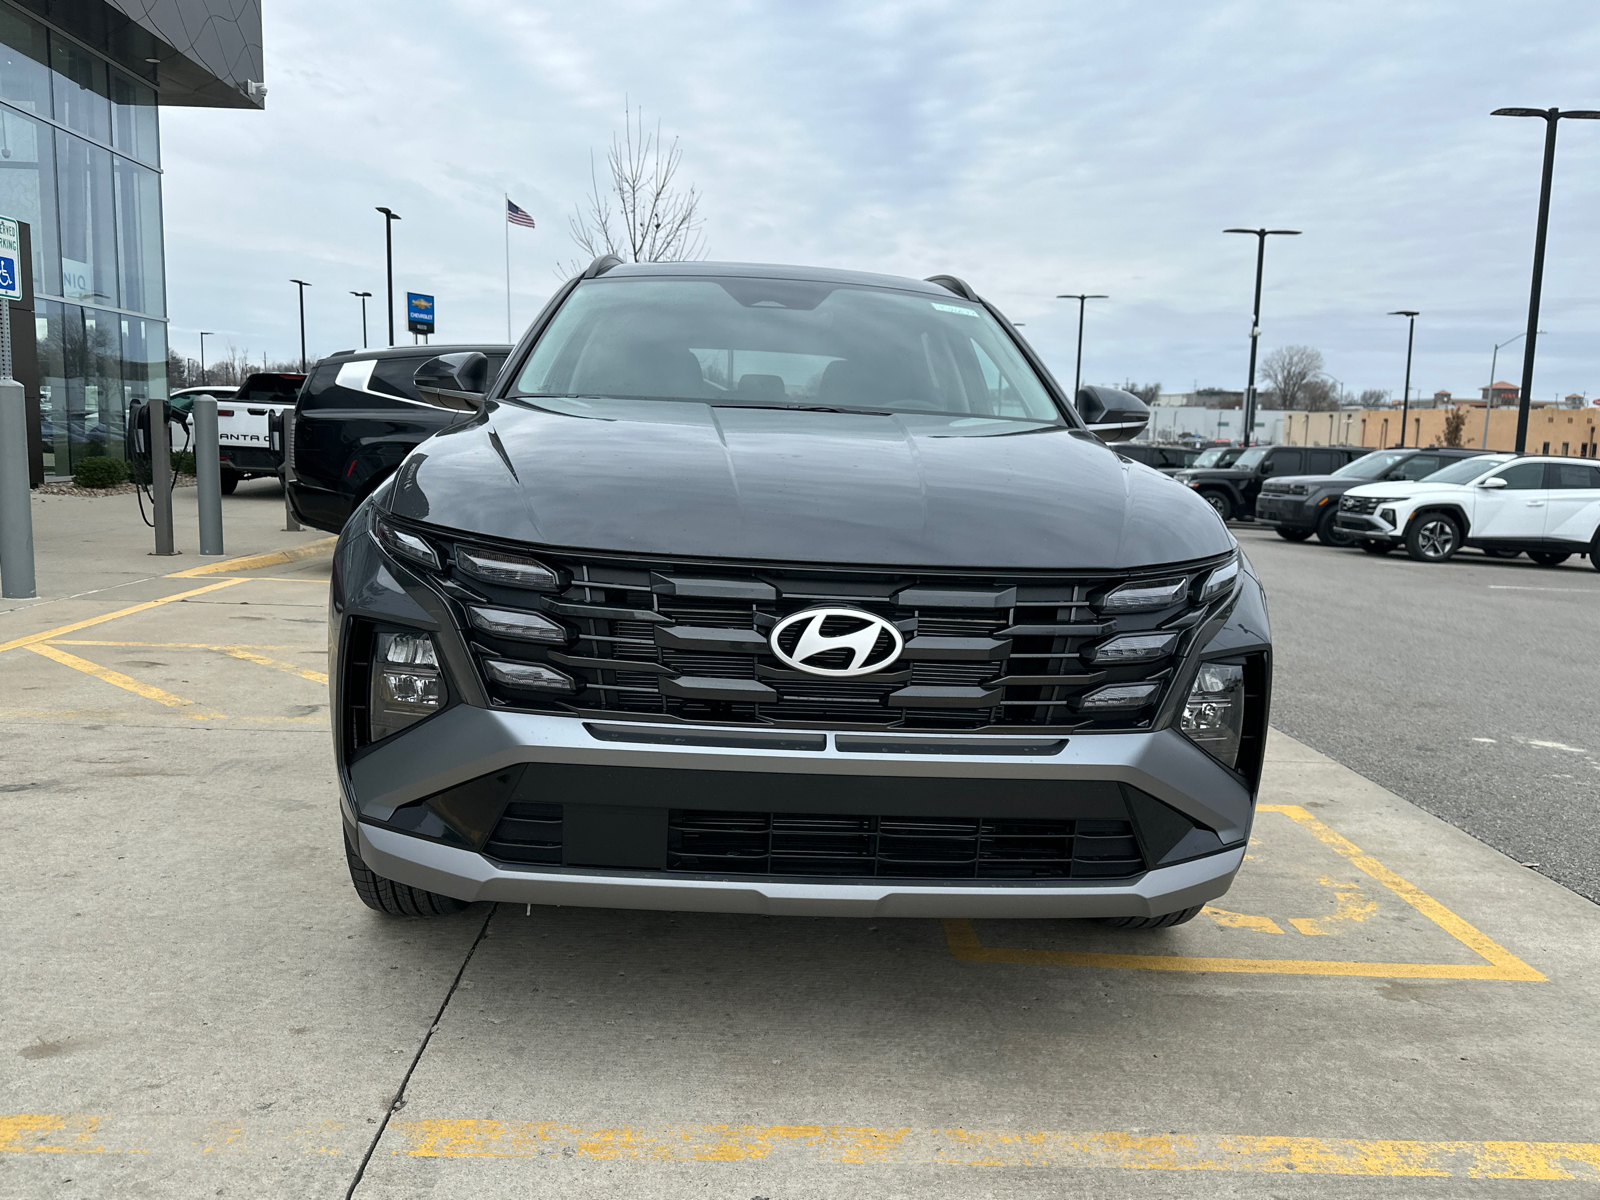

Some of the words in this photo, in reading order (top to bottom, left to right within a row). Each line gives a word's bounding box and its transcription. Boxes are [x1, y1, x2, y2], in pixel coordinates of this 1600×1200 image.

[0, 224, 15, 237] ERVED
[0, 237, 16, 251] RKING
[410, 312, 433, 320] CHEVROLET
[220, 433, 260, 441] ANTA
